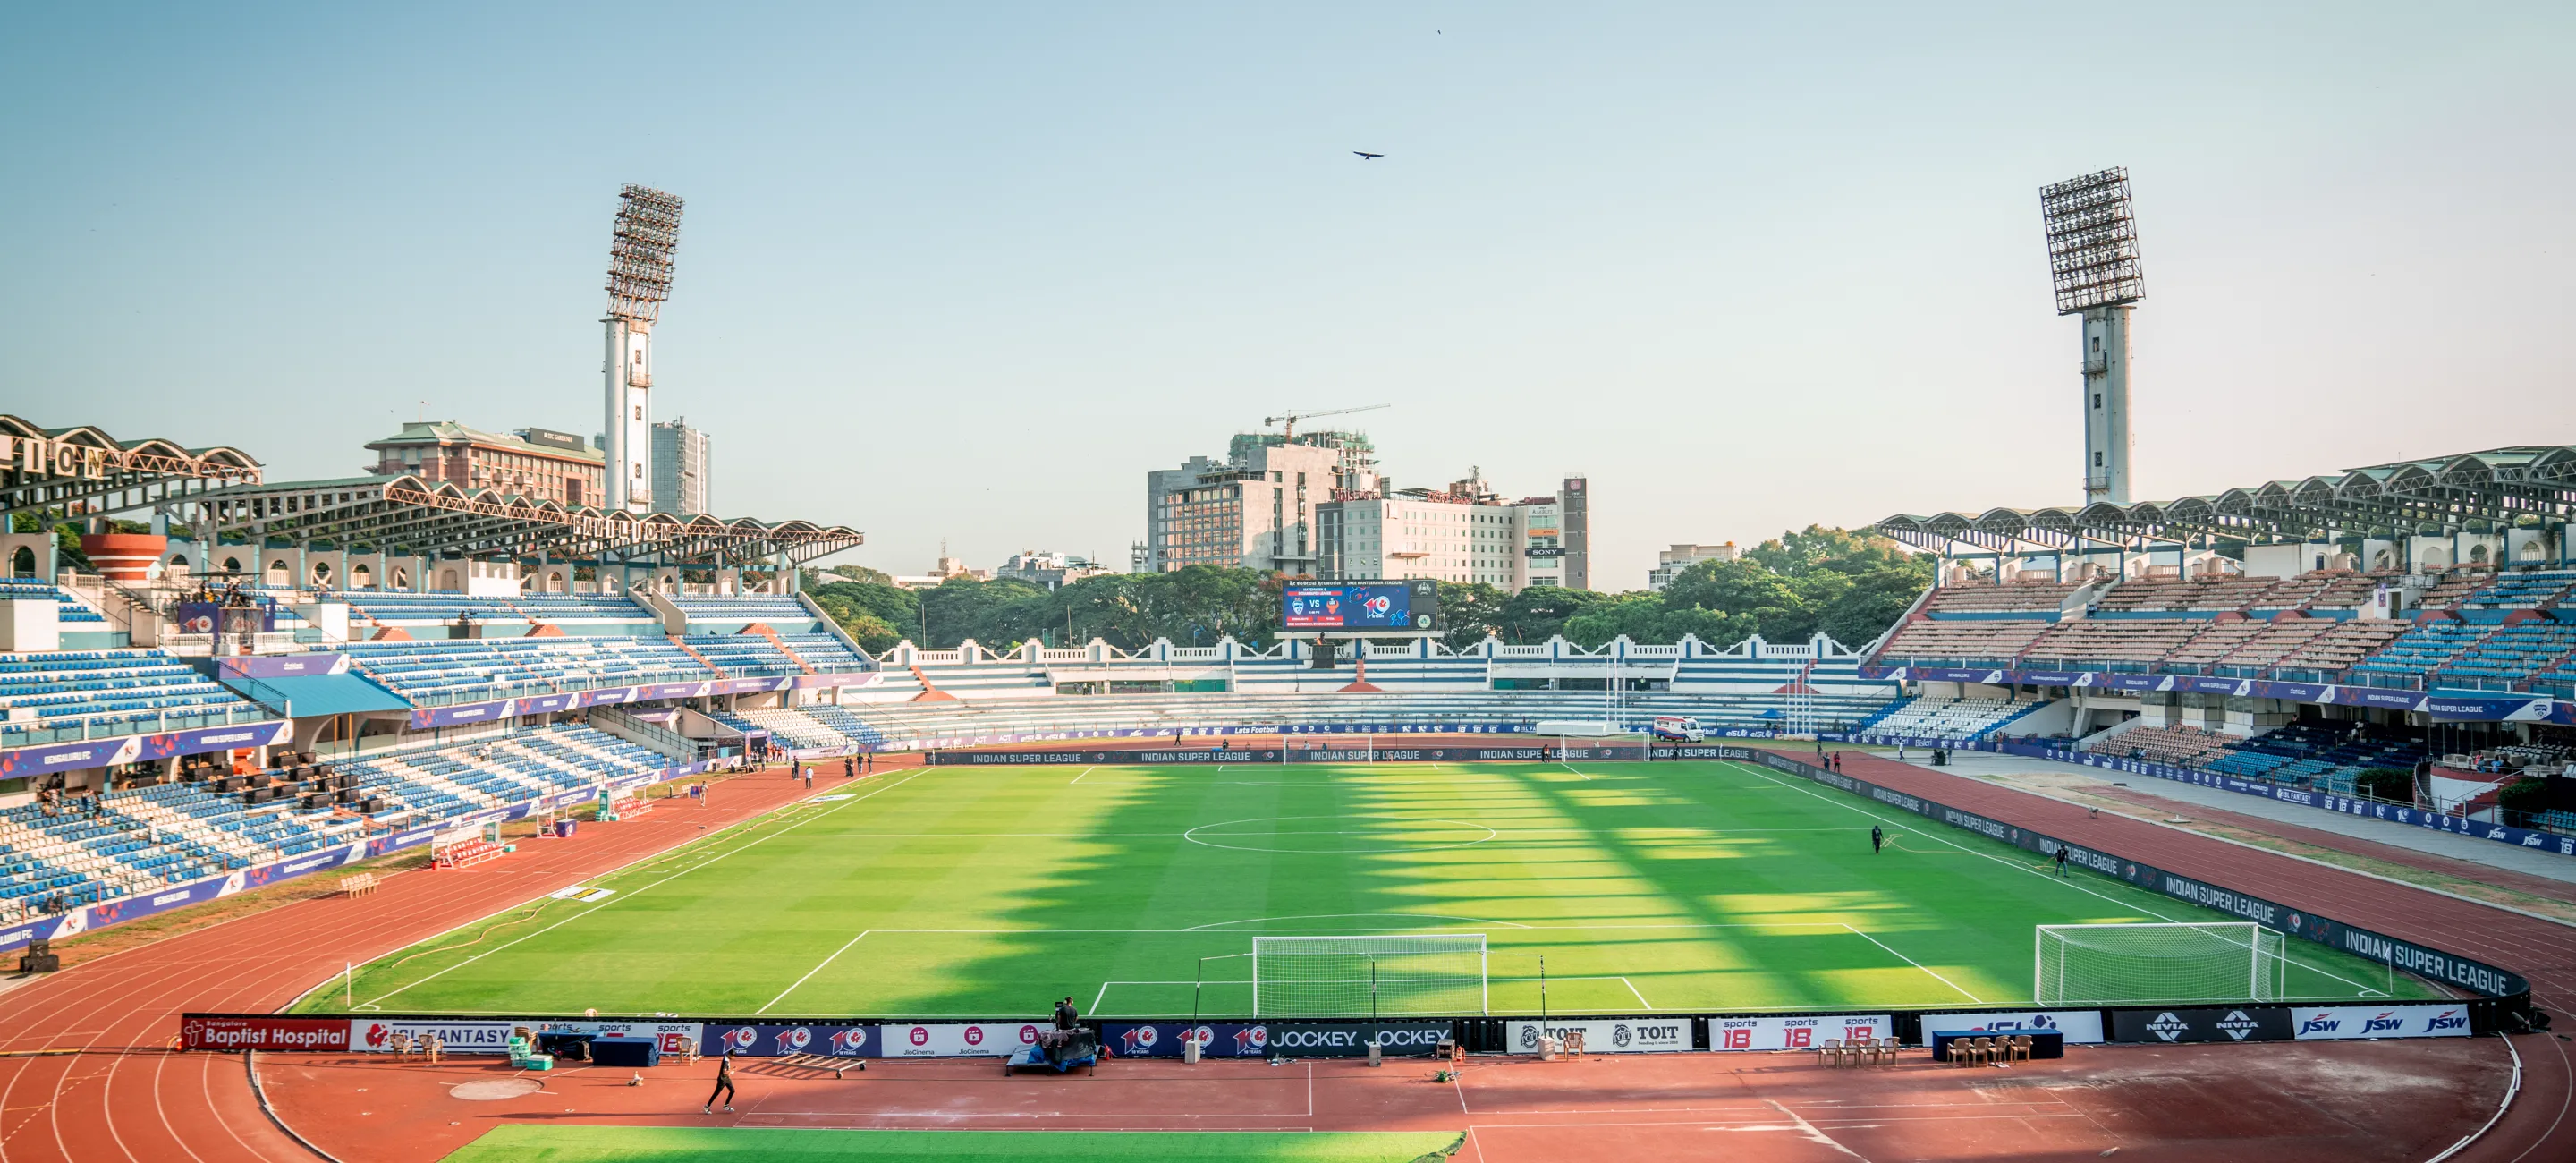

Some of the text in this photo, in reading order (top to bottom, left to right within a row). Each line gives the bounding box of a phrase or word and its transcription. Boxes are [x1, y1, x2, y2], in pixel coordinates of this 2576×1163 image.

[1335, 488, 1355, 502] ibis
[574, 516, 670, 541] PAVILION
[44, 751, 91, 764] BENGALURU FC
[973, 754, 1081, 763] INDIAN SUPER LEAGUE
[1213, 752, 1250, 760] LEAGUE
[1481, 750, 1588, 758] INDIAN SUPE LEAGUE
[1719, 749, 1749, 758] LEAGUE
[1873, 787, 1919, 811] INDIAN SUPER LEAGUE
[2291, 792, 2311, 802] FANTASY
[2324, 799, 2332, 809] 18
[2339, 802, 2346, 812] 18
[2354, 804, 2362, 814] 18
[1964, 816, 1981, 831] SUPER
[1983, 821, 2004, 838] LEAGUE
[2486, 830, 2506, 839] JSW
[2522, 837, 2542, 846] JSW
[2560, 842, 2573, 855] 18
[2064, 845, 2117, 874] UPER LEAGUE
[2167, 876, 2274, 924] INDIAN SUPER LEAGUE
[22, 929, 33, 939] FC
[2346, 930, 2507, 996] INDIAN SUPER LEAGUE
[1724, 1020, 1757, 1028] sports
[1785, 1019, 1818, 1027] sports
[1845, 1017, 1878, 1025] sports
[2297, 1020, 2341, 1035] JSW
[2360, 1019, 2403, 1034] JSW
[2423, 1017, 2467, 1033] JSW
[205, 1028, 346, 1047] Baptist Hospital
[1271, 1031, 1357, 1047] JOCKEY
[1364, 1029, 1449, 1046] JOCKEY
[1521, 1031, 1540, 1044] TOIT
[1613, 1030, 1632, 1044] TOIT
[1637, 1026, 1678, 1039] TOIT
[1782, 1028, 1812, 1047] 18
[1721, 1030, 1751, 1049] 18
